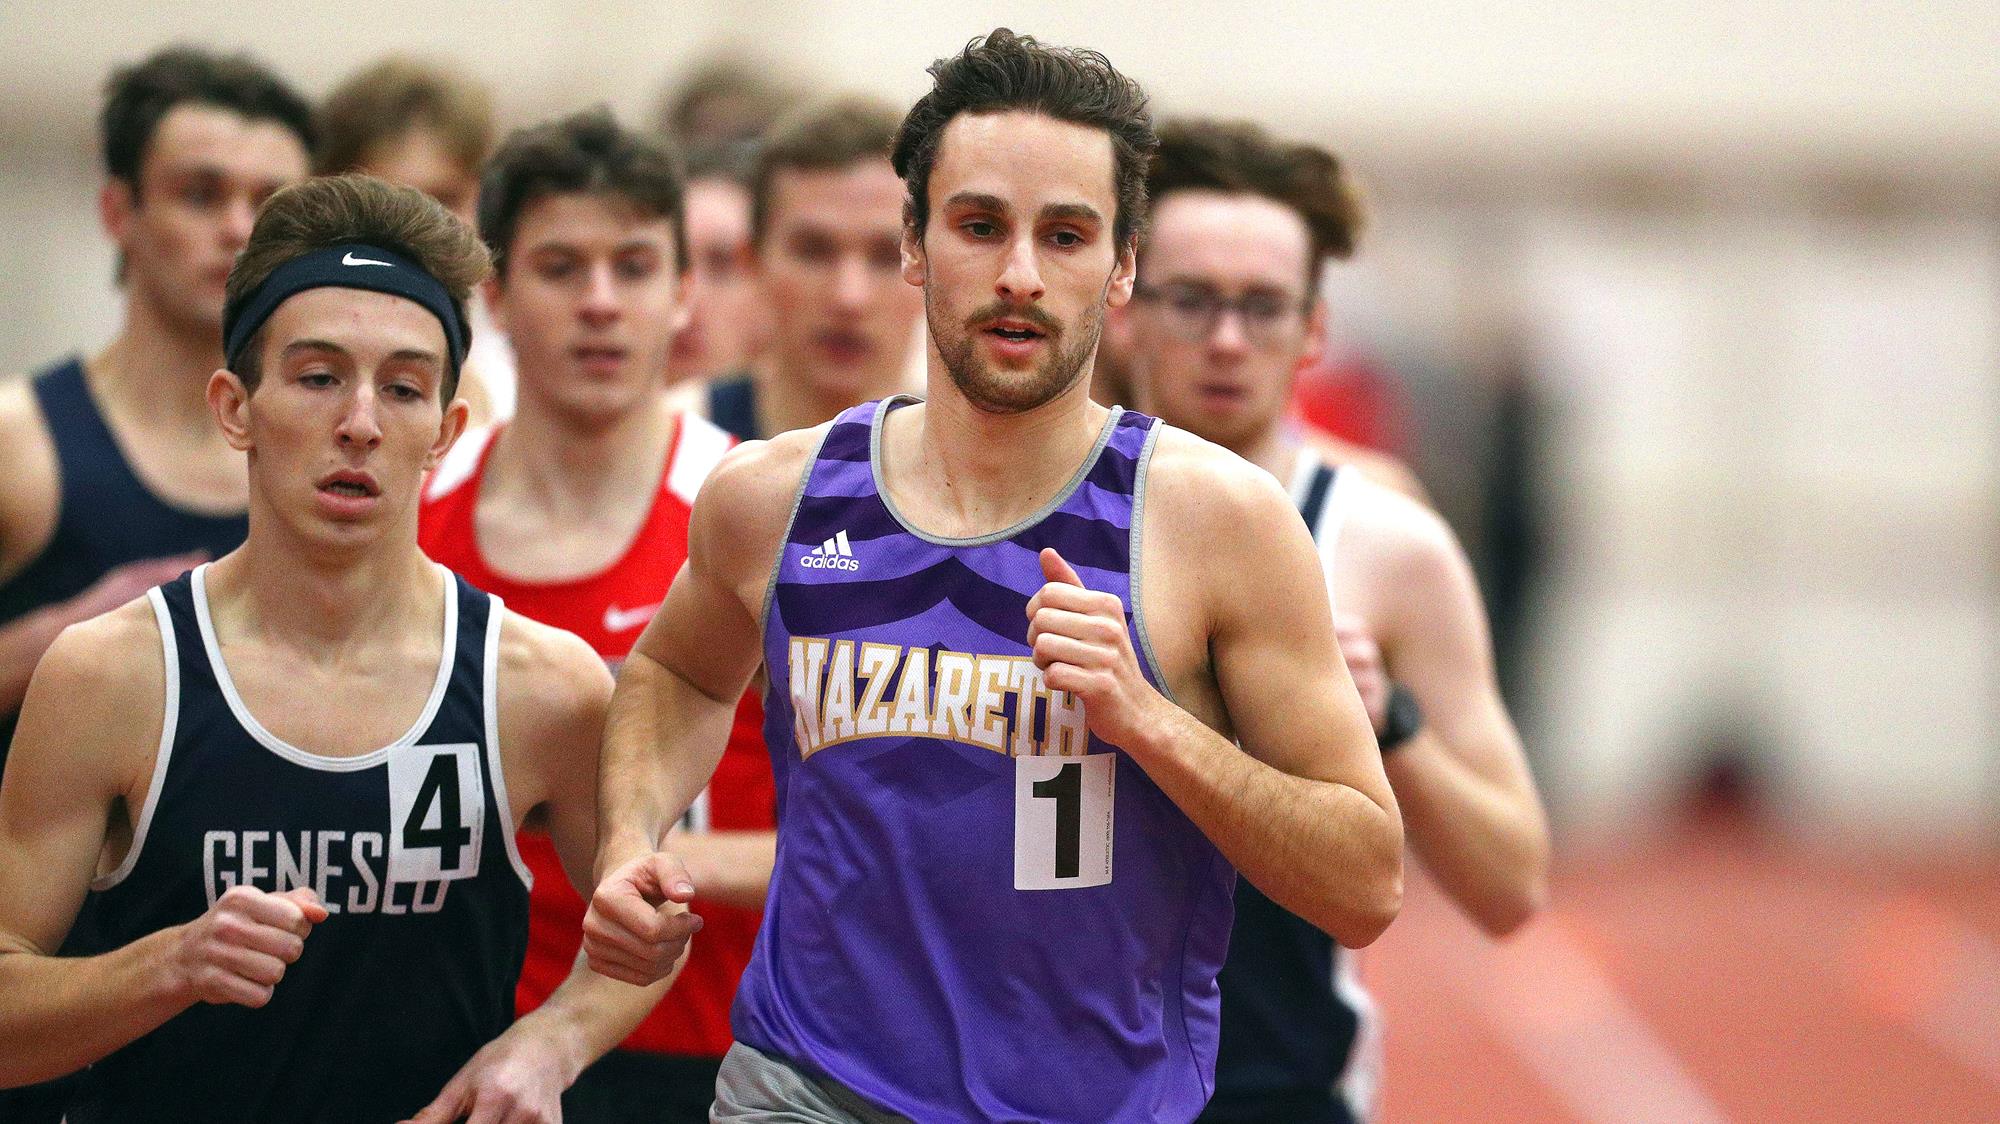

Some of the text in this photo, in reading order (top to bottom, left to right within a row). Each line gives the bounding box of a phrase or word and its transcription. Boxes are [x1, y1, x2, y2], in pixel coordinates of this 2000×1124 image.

[800, 554, 860, 571] adidas
[788, 636, 1090, 762] NAZARETH
[403, 754, 470, 871] 4
[1033, 763, 1082, 879] 1
